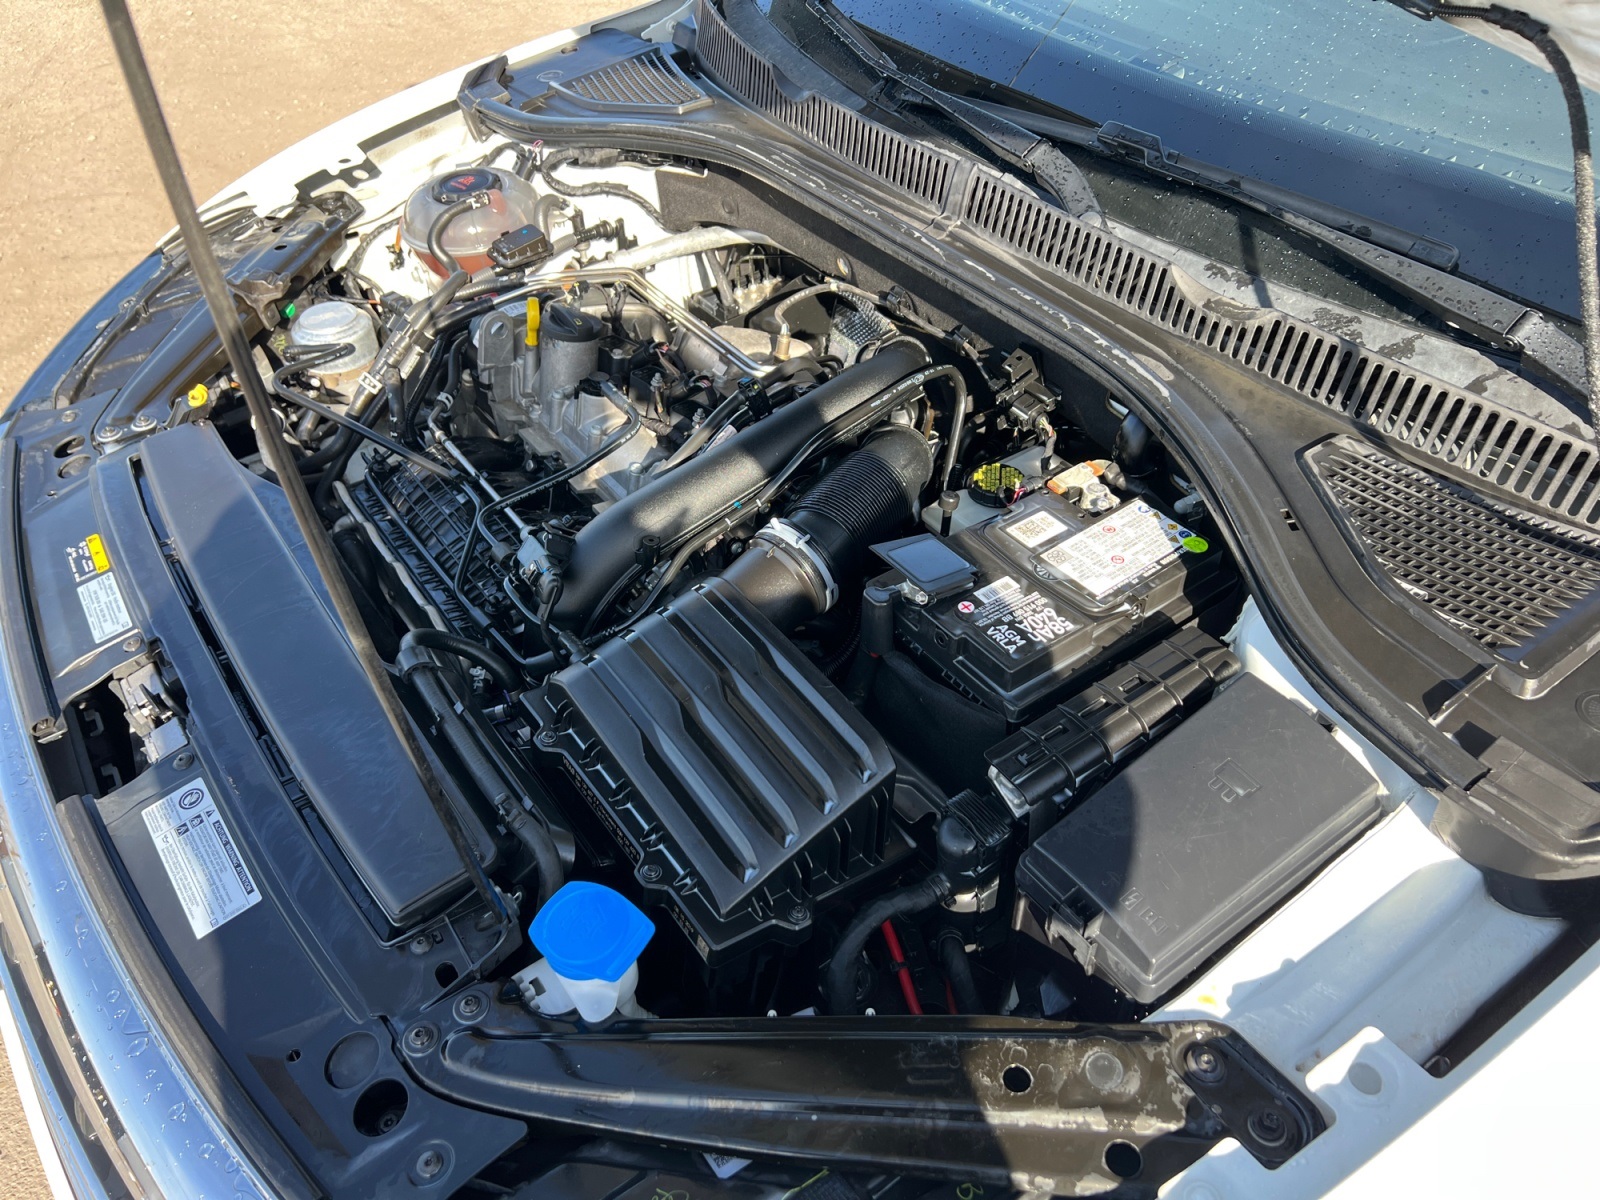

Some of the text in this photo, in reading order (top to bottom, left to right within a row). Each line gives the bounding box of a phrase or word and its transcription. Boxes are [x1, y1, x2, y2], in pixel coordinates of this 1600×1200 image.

[1015, 607, 1057, 633] 640A
[1027, 617, 1075, 643] 58Ah
[987, 626, 1017, 654] VRLA
[996, 625, 1027, 646] AGM
[214, 821, 253, 892] ACHTUNG WARNING ATTENTION
